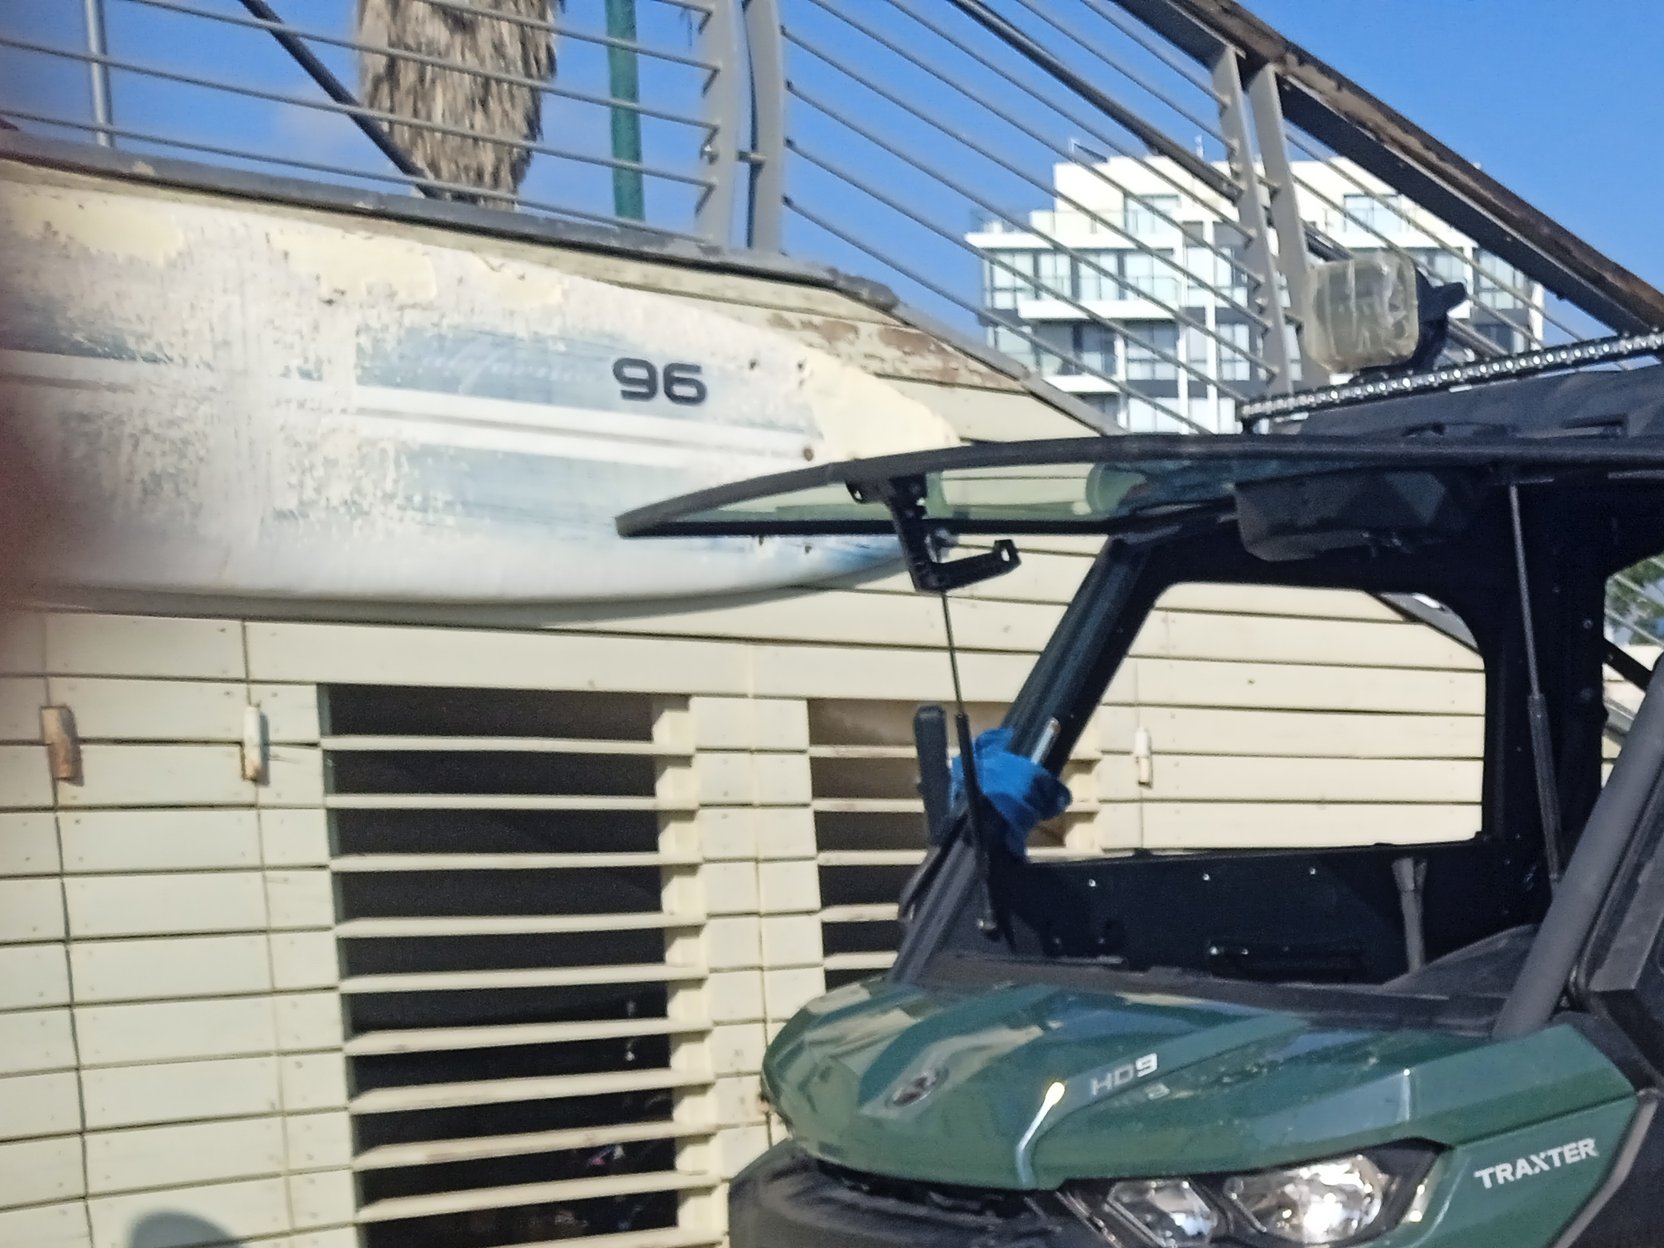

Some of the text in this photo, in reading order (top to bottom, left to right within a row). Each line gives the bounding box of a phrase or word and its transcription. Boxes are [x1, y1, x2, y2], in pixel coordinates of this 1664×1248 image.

[612, 357, 708, 406] 96
[1090, 1052, 1158, 1096] HD9
[1473, 1138, 1599, 1189] TRAXTER
